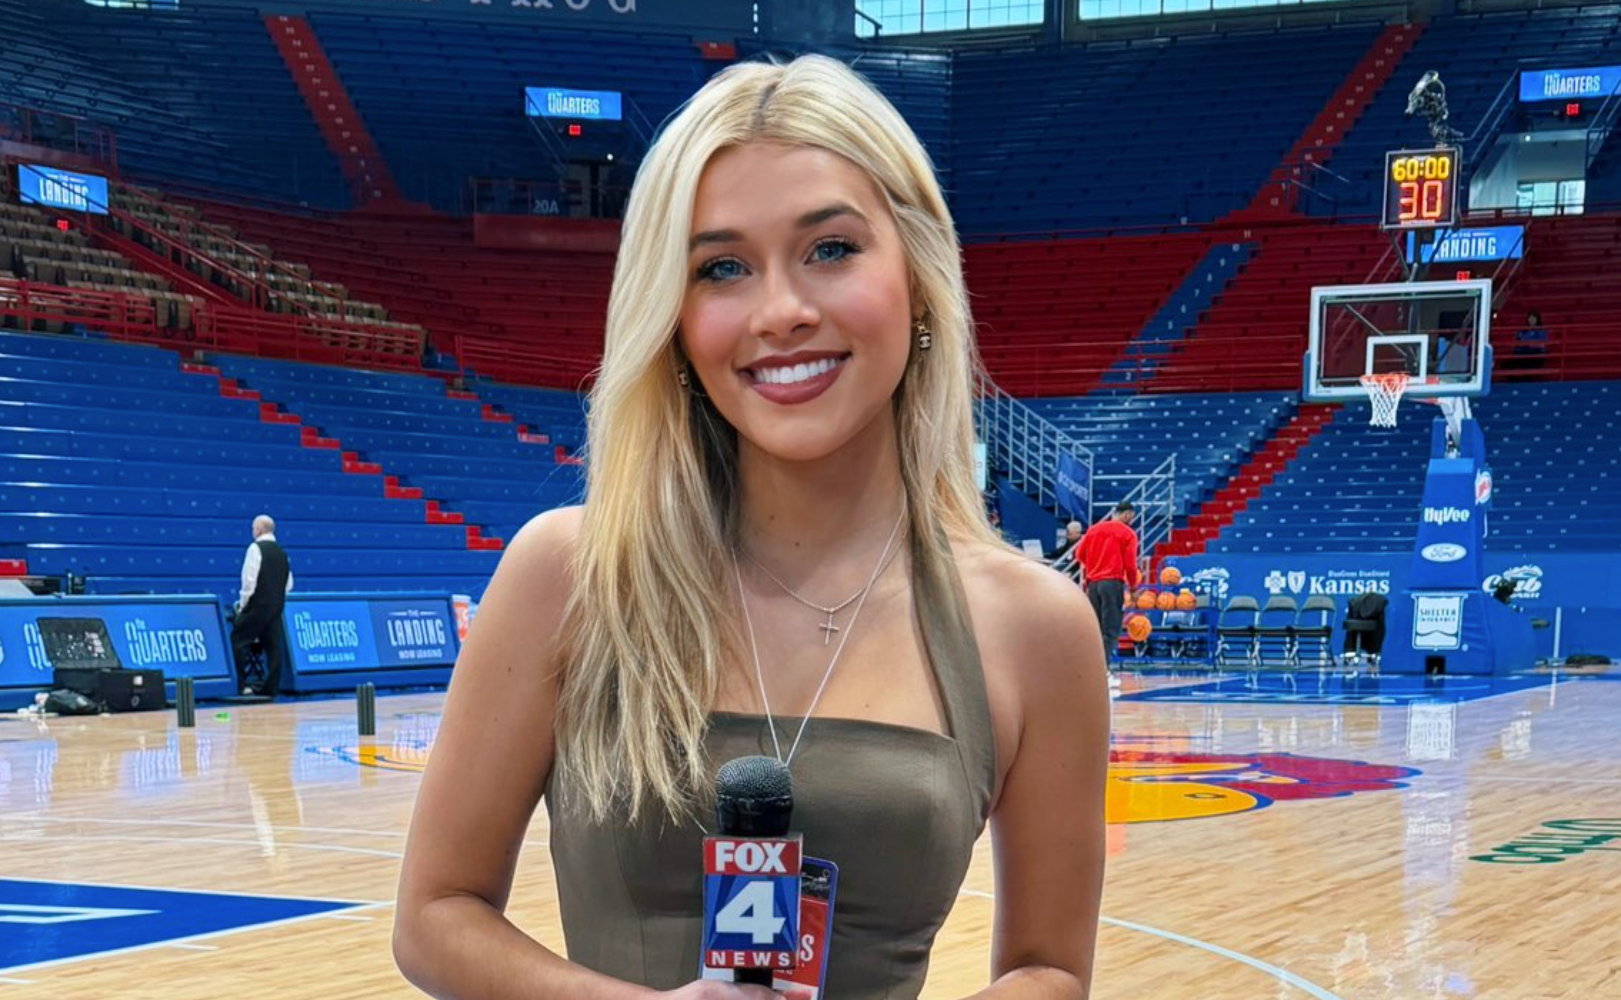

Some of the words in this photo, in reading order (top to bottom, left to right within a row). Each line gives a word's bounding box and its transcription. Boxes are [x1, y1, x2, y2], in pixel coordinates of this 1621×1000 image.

[1544, 73, 1600, 97] QUARTERS
[547, 91, 600, 115] QUARTERS
[1392, 156, 1450, 181] 60:00
[533, 199, 560, 215] 20A
[1398, 180, 1442, 219] 30
[1429, 547, 1458, 559] Ford
[1309, 576, 1390, 595] Kansas
[407, 609, 419, 617] THE
[1419, 607, 1457, 616] SHELTER
[125, 620, 207, 666] QUARTERS
[294, 612, 359, 651] QUARTERS
[387, 618, 446, 647] LANDING
[715, 841, 787, 873] FOX
[715, 880, 786, 945] 4
[711, 952, 790, 966] NEWS
